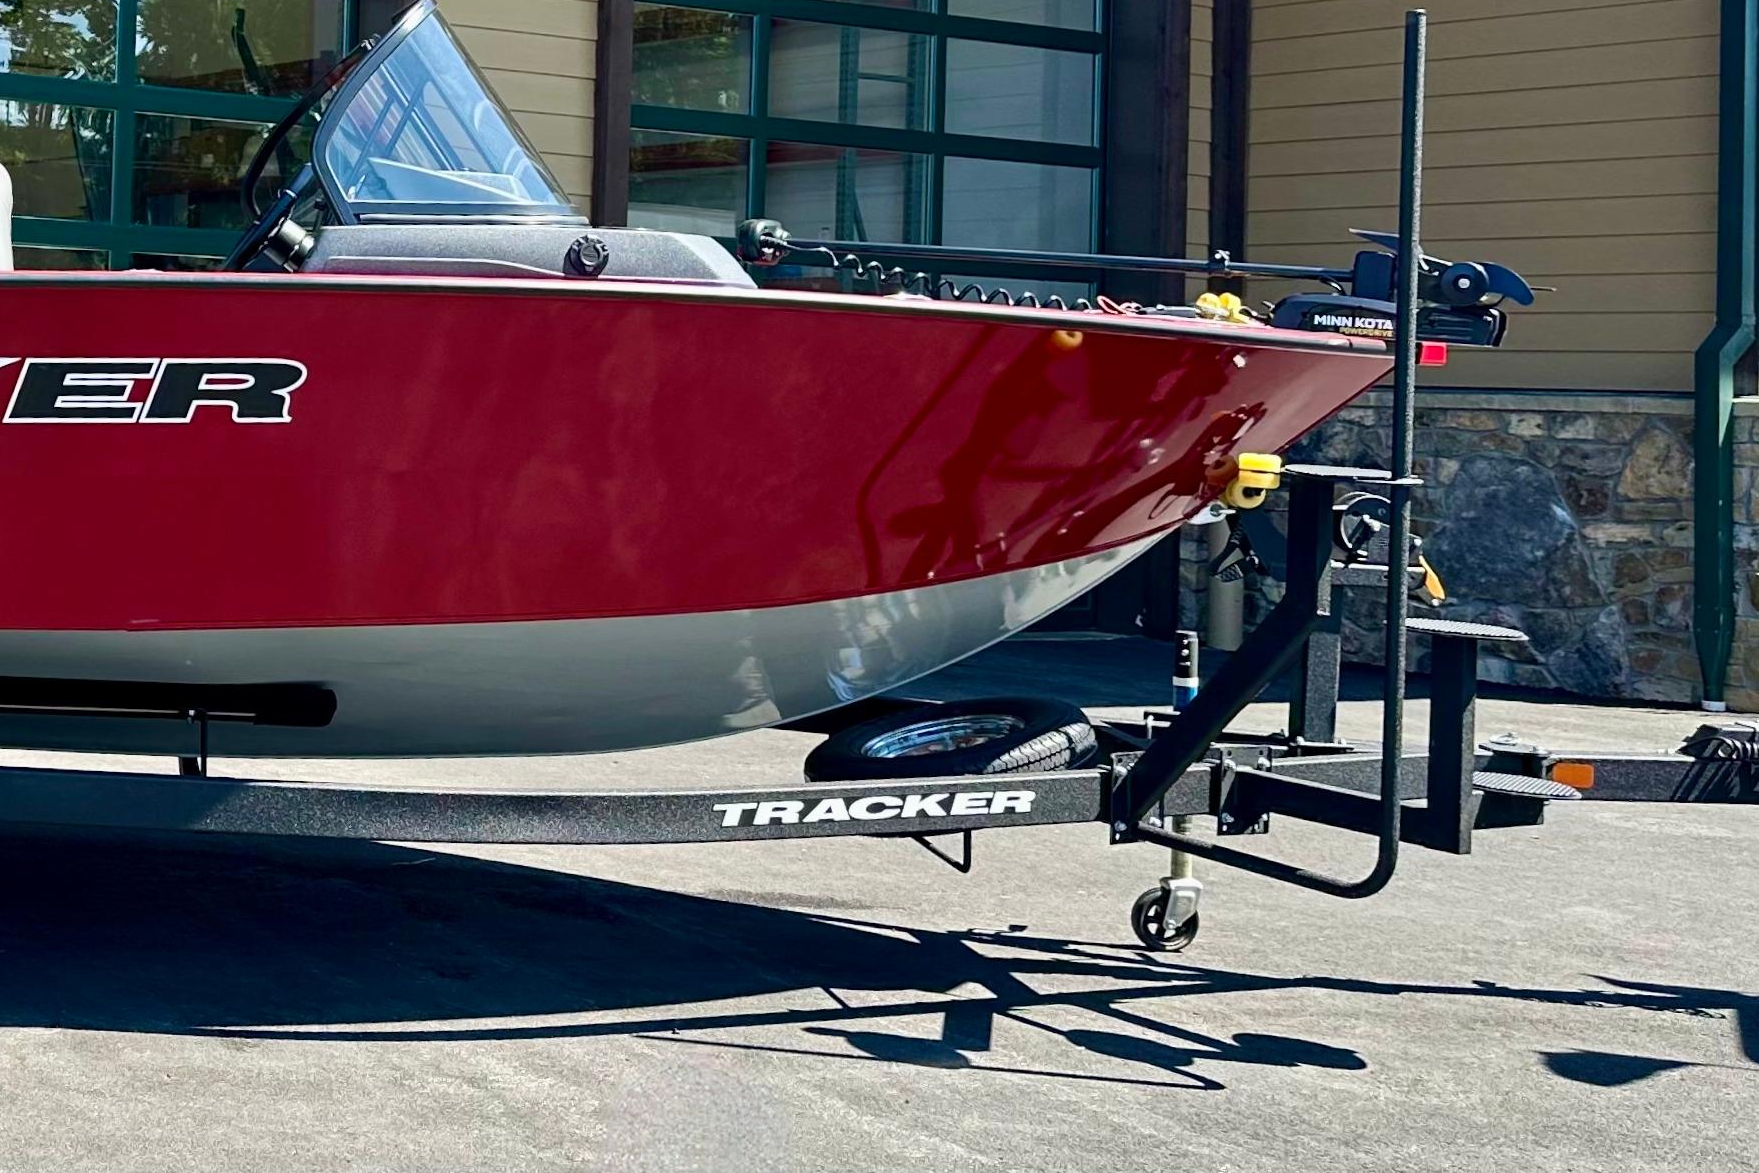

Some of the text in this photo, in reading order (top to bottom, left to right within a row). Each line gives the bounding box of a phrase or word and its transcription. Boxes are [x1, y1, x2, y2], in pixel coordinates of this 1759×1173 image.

[1314, 315, 1393, 329] MINN KOTA
[713, 790, 1036, 828] TRACKER
